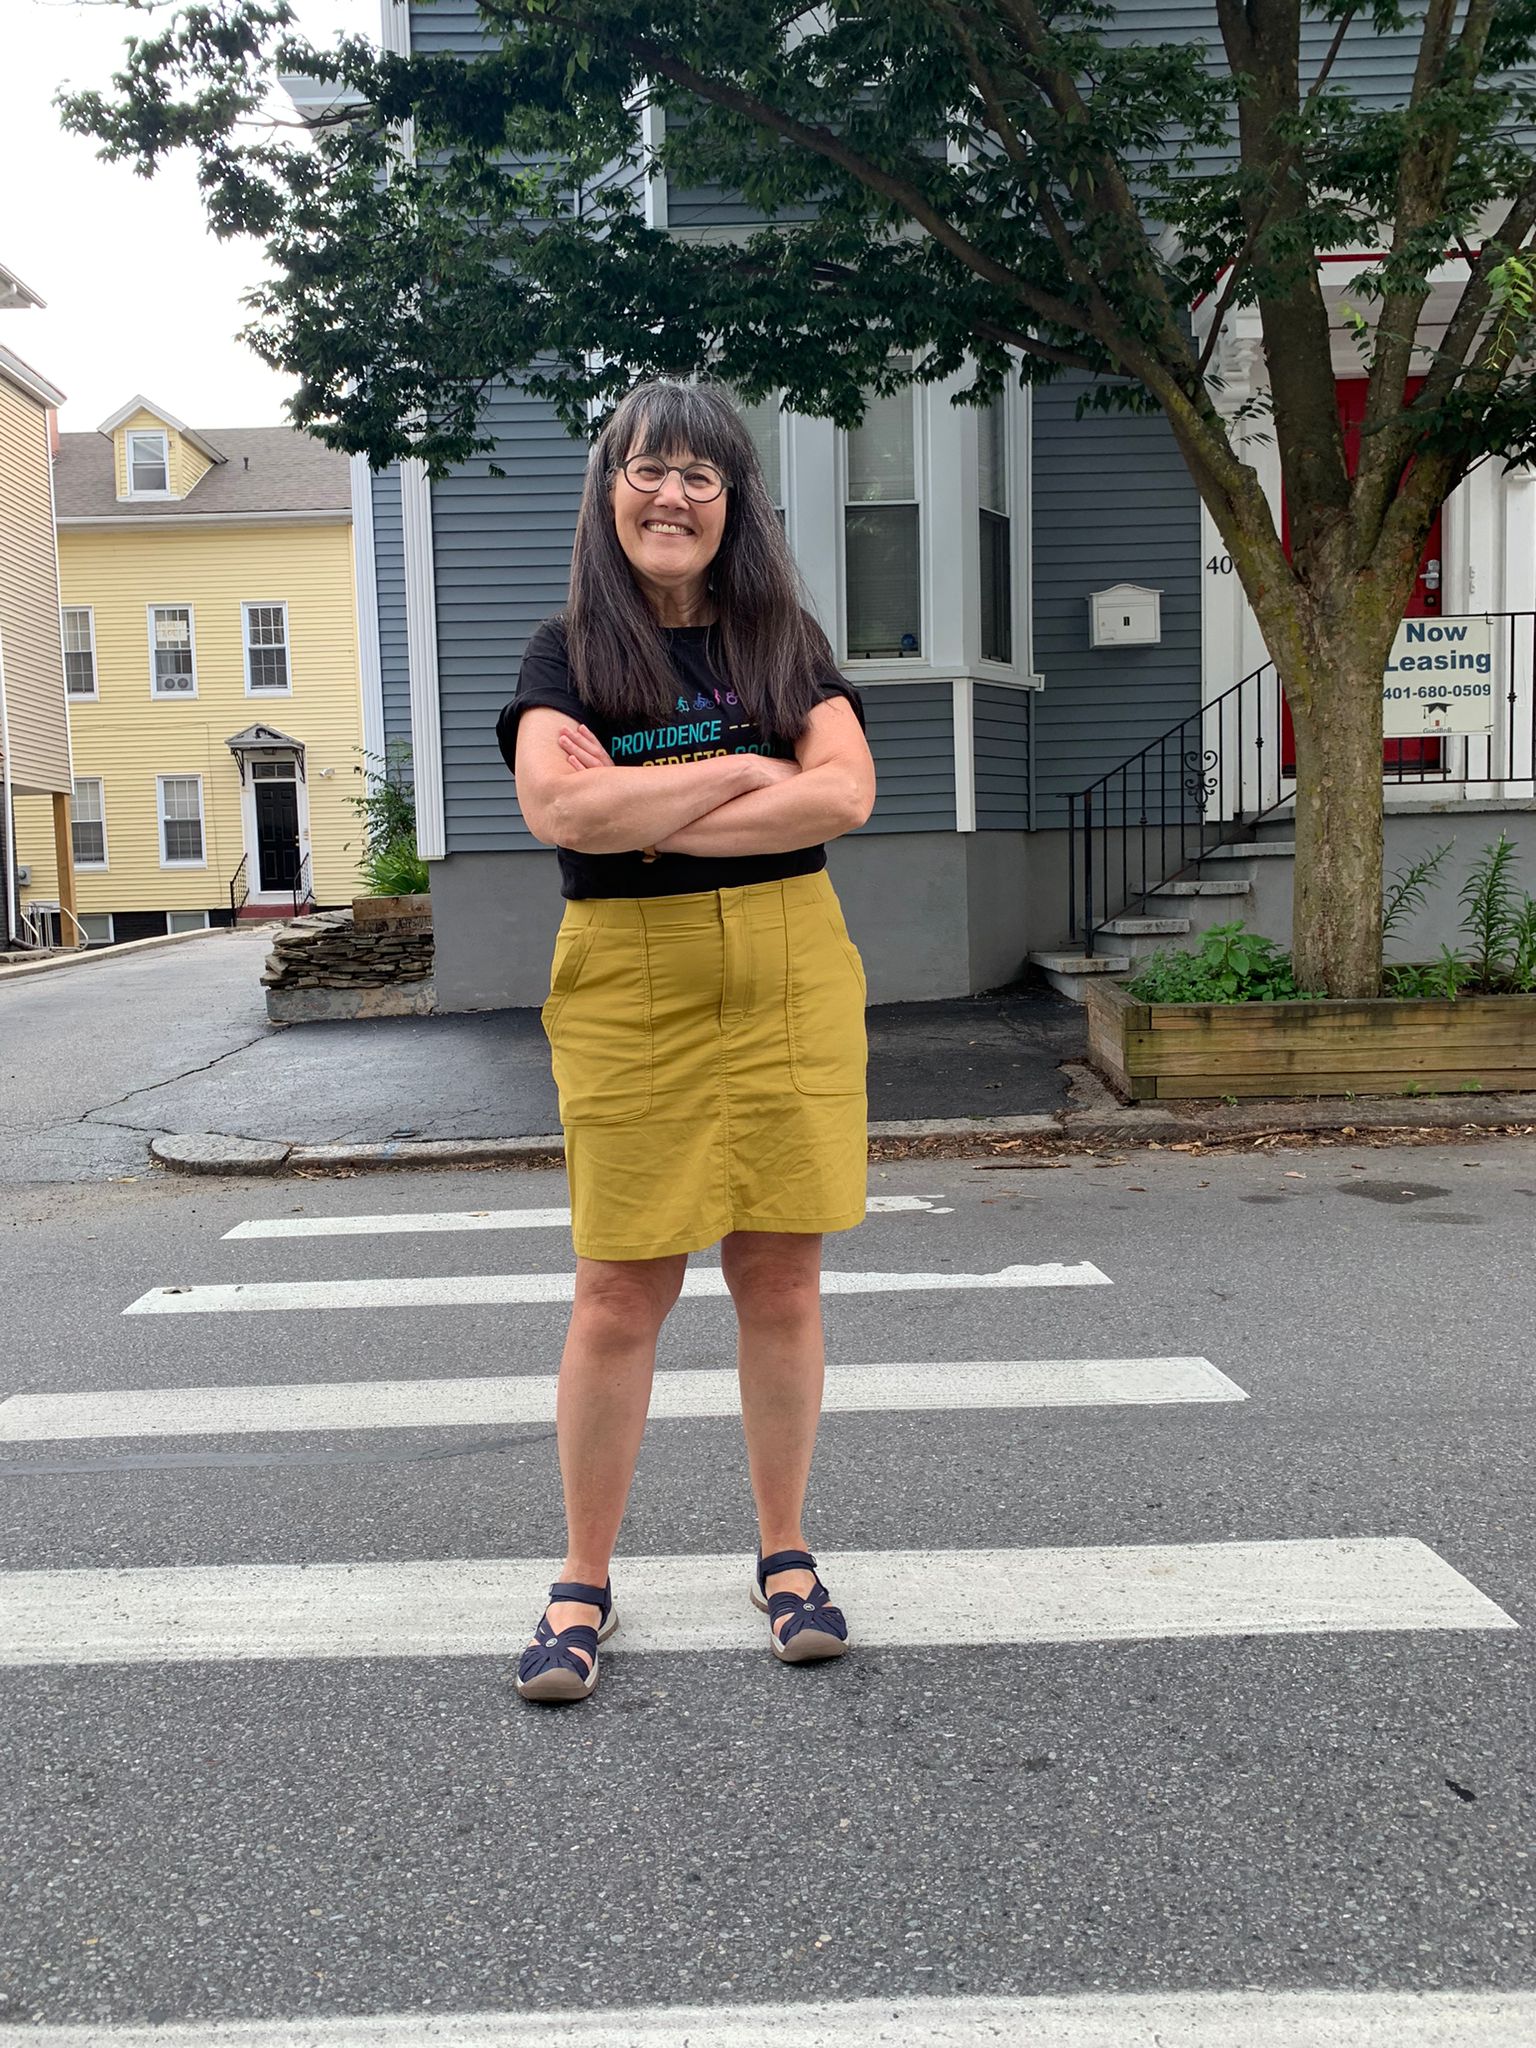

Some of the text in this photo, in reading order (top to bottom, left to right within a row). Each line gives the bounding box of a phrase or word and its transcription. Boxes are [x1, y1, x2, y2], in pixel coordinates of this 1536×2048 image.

[1206, 556, 1233, 574] 40
[1406, 623, 1467, 642] Now
[1383, 684, 1491, 699] 401-680-0509
[611, 720, 722, 757] PROVIDENCE
